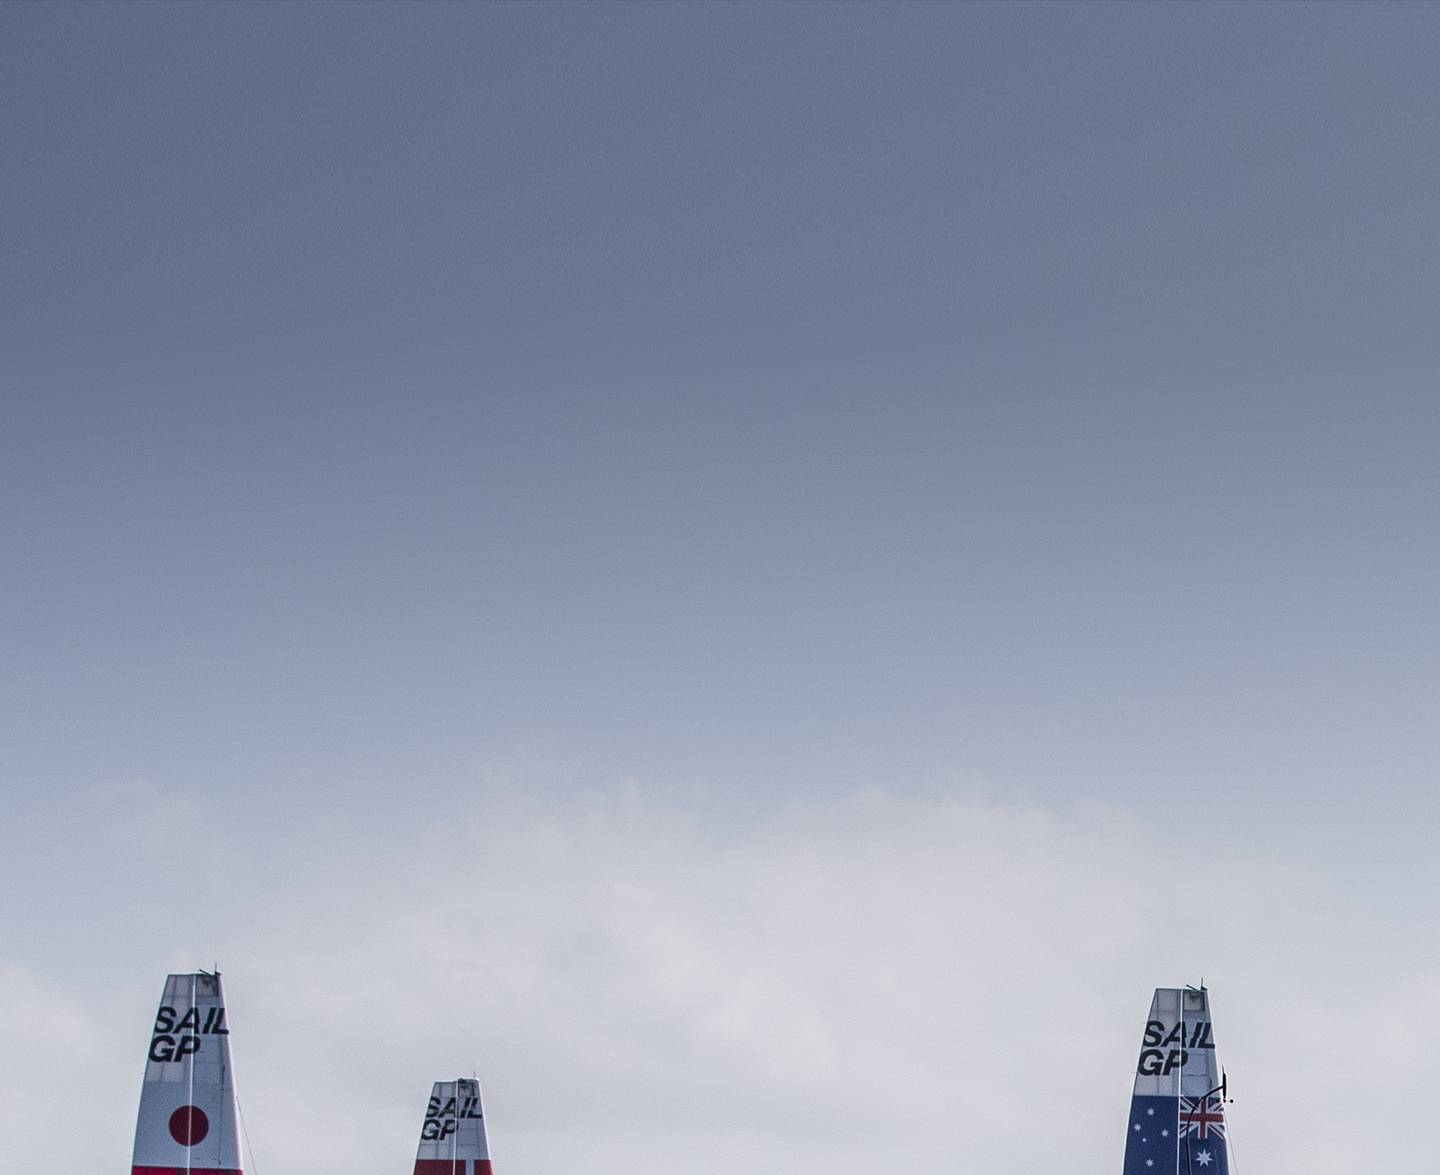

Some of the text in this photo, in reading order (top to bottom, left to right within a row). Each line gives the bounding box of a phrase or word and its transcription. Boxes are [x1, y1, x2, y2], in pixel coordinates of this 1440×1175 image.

[154, 1006, 230, 1035] SAIL
[1143, 1020, 1216, 1049] SAIL
[148, 1035, 201, 1062] GP
[1138, 1050, 1189, 1076] GP
[425, 1096, 482, 1119] SAIL
[420, 1119, 459, 1141] GP
